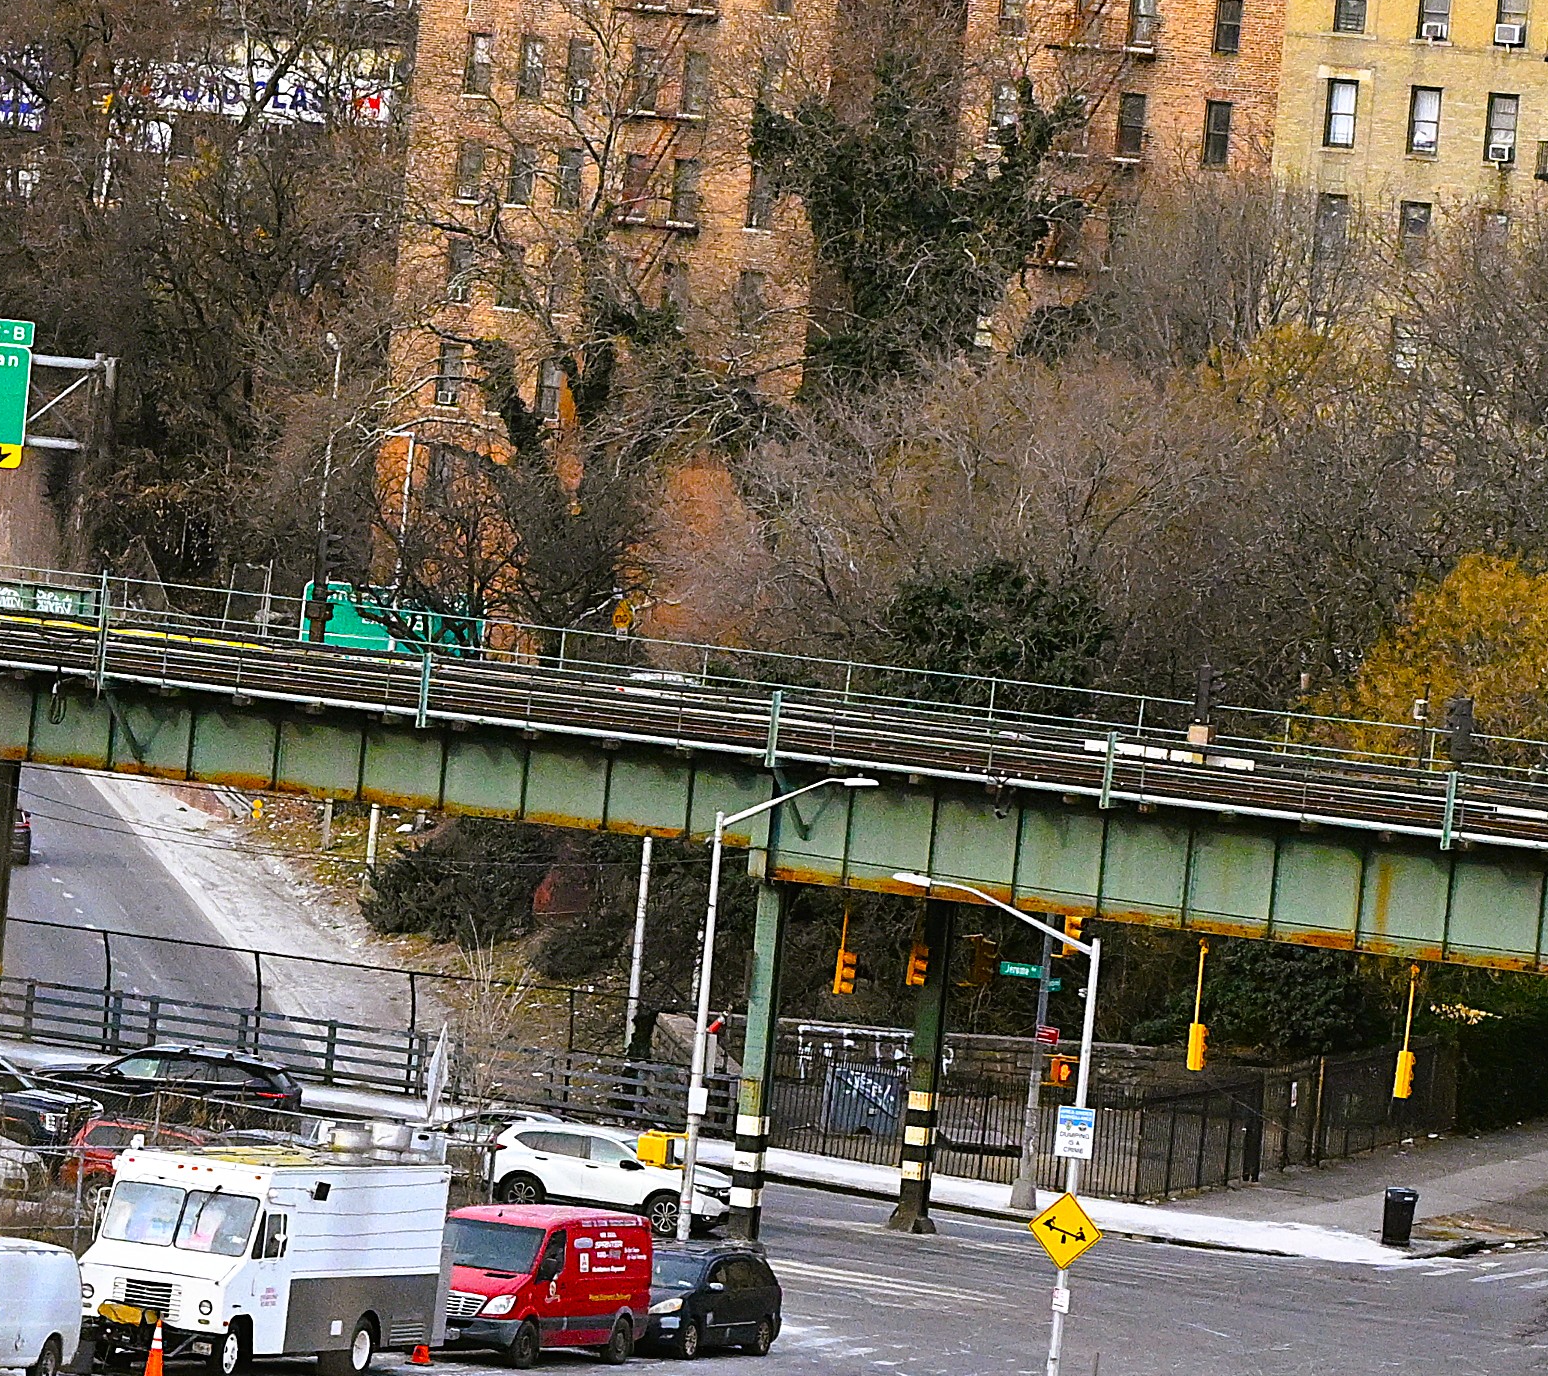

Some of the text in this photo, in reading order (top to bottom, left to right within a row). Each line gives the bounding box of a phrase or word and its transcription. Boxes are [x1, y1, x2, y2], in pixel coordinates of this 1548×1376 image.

[1005, 965, 1030, 976] Jerome
[1059, 1131, 1090, 1140] DUMPING
[1063, 1146, 1084, 1155] CRIME
